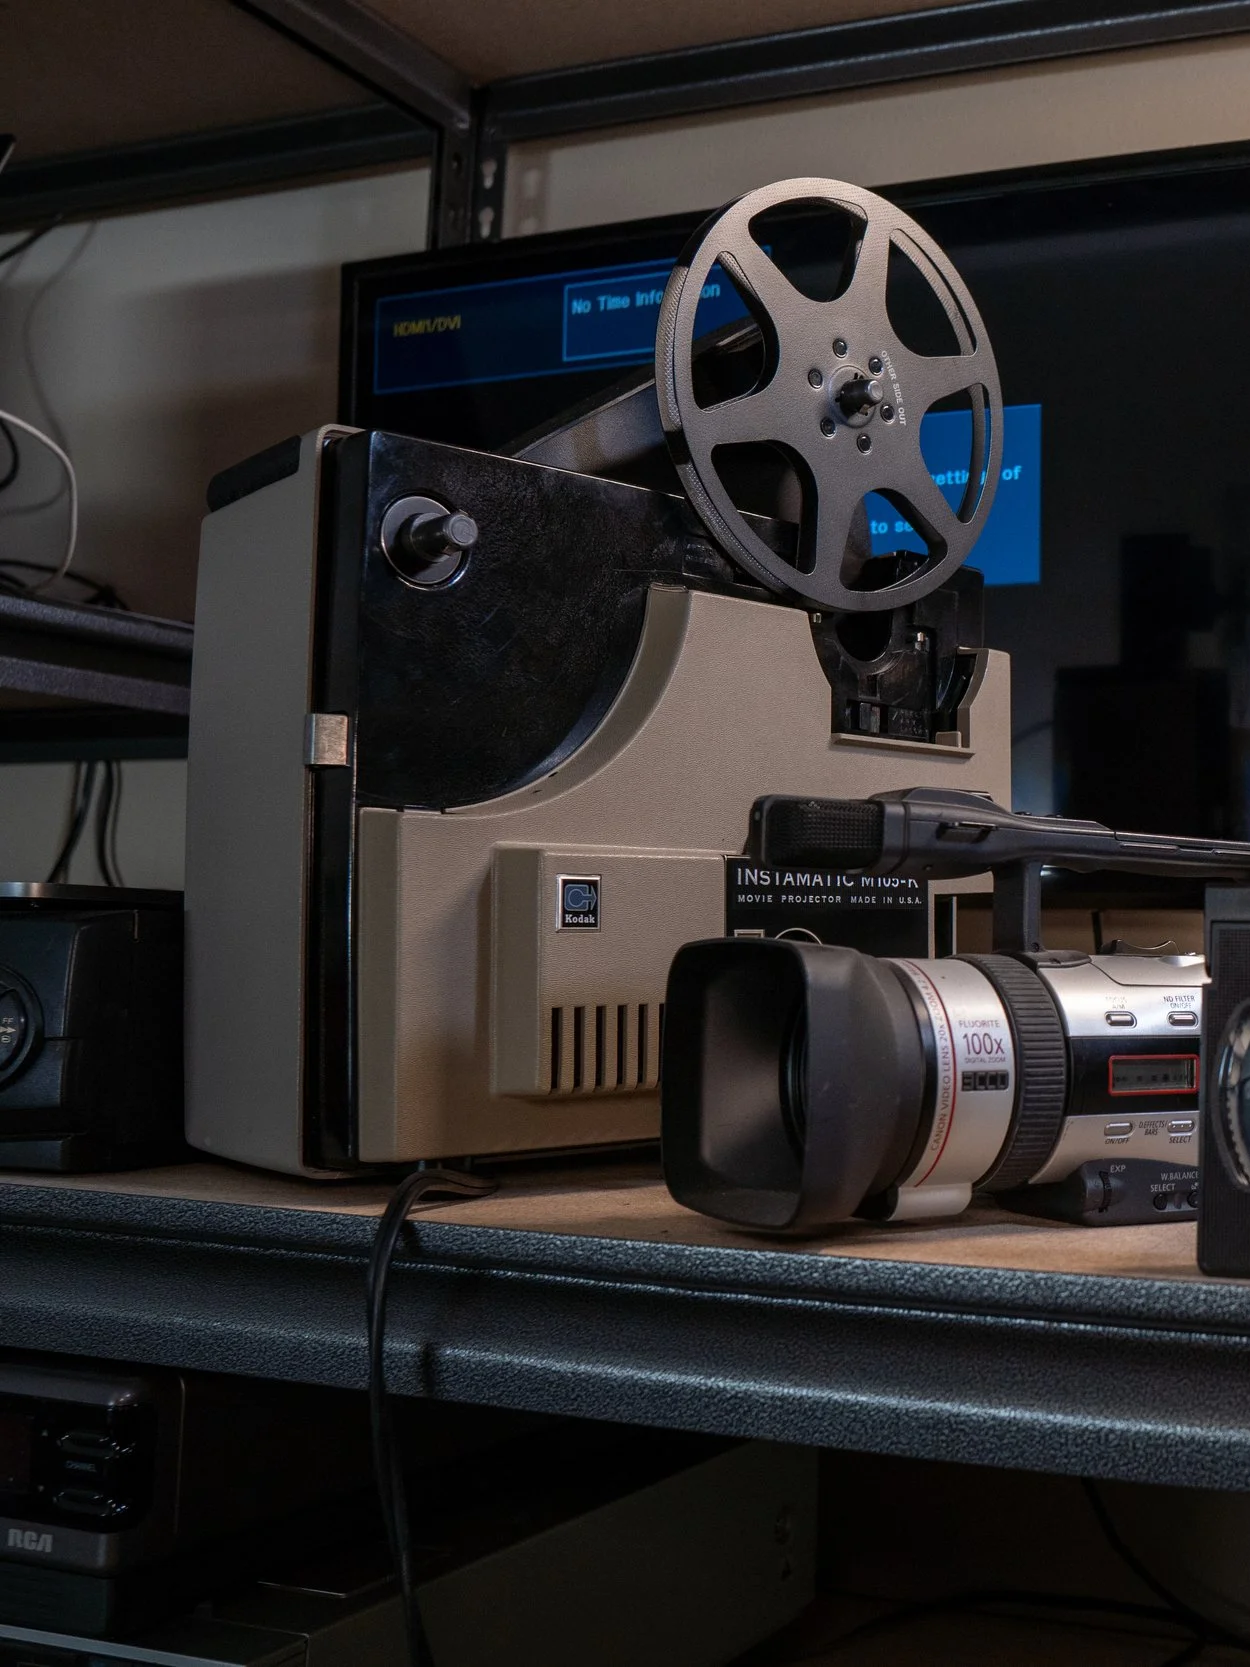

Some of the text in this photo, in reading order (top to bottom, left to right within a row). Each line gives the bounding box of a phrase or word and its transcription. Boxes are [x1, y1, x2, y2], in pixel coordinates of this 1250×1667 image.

[571, 297, 592, 316] No
[598, 294, 630, 312] Time
[881, 350, 907, 426] OTHER SIDE OUT
[1002, 465, 1022, 481] of
[870, 519, 888, 535] to
[737, 894, 922, 905] MOVIE PROJECTOR MADE IN U.S.A.
[565, 914, 595, 924] Kodak
[959, 1019, 1000, 1028] FLUORITE
[963, 1032, 1005, 1055] 100x
[941, 1046, 950, 1072] LENS
[964, 1056, 1006, 1064] DIGITAL ZOOM
[941, 1076, 951, 1111] VIDEO
[931, 1114, 946, 1151] CANON
[1169, 1136, 1192, 1144] SELECT
[1110, 1164, 1126, 1173] EXP
[1150, 1183, 1176, 1192] SELECT
[8, 1528, 54, 1552] RCA
